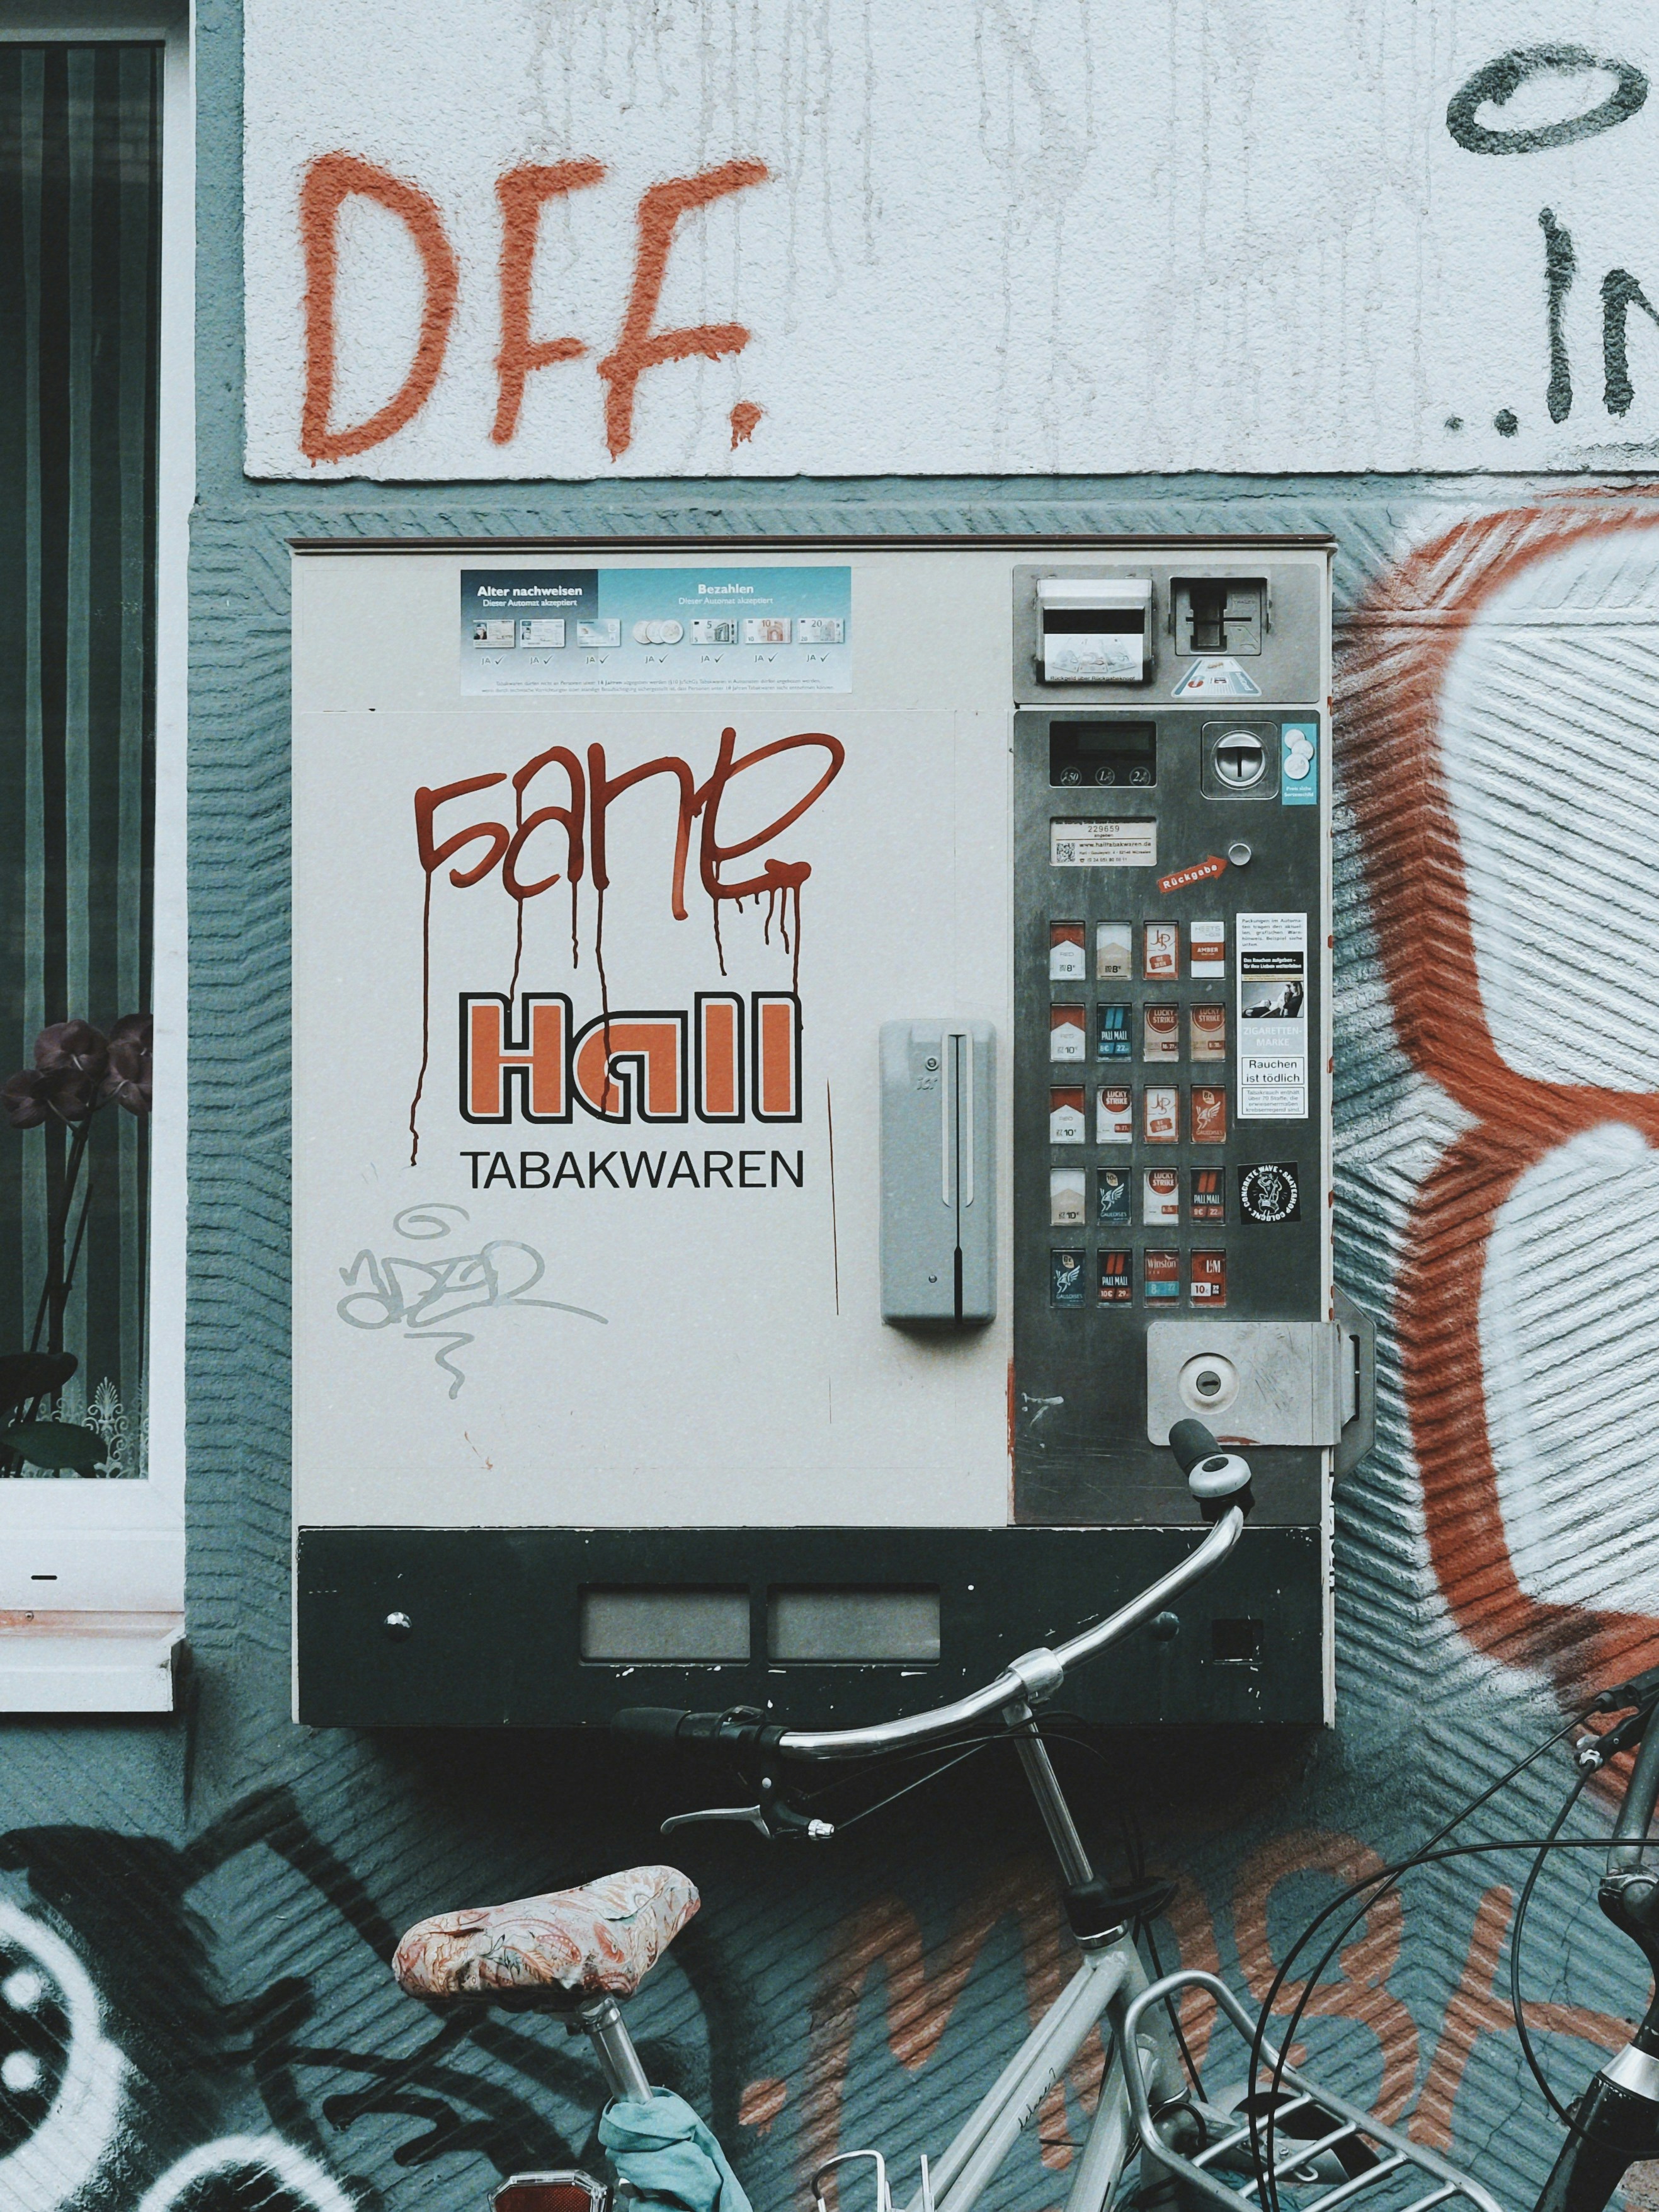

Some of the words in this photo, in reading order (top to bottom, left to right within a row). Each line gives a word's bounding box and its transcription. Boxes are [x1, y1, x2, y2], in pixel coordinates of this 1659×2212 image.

[477, 585, 510, 597] Alter
[512, 585, 583, 597] nachweisen
[698, 583, 754, 594] Bezahlen
[482, 599, 506, 607] Dieser
[508, 599, 539, 607] Automat
[541, 599, 578, 608] akzeptiert
[678, 597, 702, 605] Dieser
[704, 597, 735, 605] Automat
[737, 597, 774, 606] akzeptiert
[481, 656, 491, 665] JA
[530, 656, 540, 665] JA
[586, 656, 596, 665] JA
[644, 655, 655, 663] JA
[700, 655, 710, 663] JA
[754, 654, 764, 663] JA
[806, 653, 816, 662] JA
[1162, 864, 1218, 890] Rückgabe
[1243, 1026, 1303, 1035] ZIGARETTEN-
[1256, 1038, 1290, 1046] MARKE
[459, 990, 803, 1125] Hall
[1249, 1060, 1297, 1069] Rauchen
[1246, 1074, 1259, 1082] ist
[1263, 1073, 1300, 1083] tödlich
[1106, 1097, 1128, 1105] STRIKE
[460, 1150, 804, 1189] TABAKWAREN
[1258, 1164, 1279, 1172] WAVE
[1152, 1179, 1175, 1187] STRIKE
[1194, 1194, 1206, 1204] PALL
[1206, 1194, 1221, 1204] MALL
[1147, 1258, 1177, 1269] Winston
[1102, 1276, 1114, 1286] PALL
[1114, 1276, 1128, 1286] MALL
